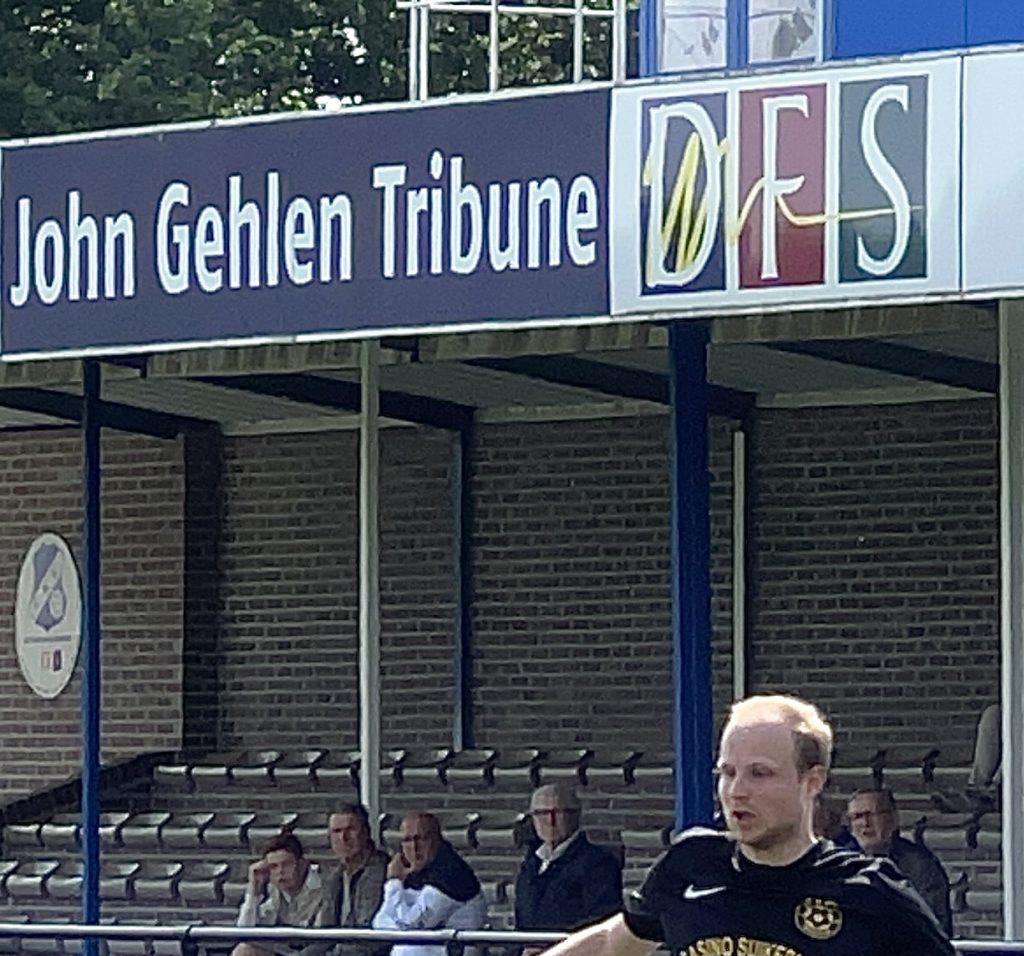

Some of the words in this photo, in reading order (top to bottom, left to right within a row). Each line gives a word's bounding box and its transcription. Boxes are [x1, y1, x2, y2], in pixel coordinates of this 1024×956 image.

[10, 191, 135, 306] John
[156, 171, 352, 294] Gehlen
[373, 150, 599, 278] Tribune
[645, 84, 912, 288] DFS
